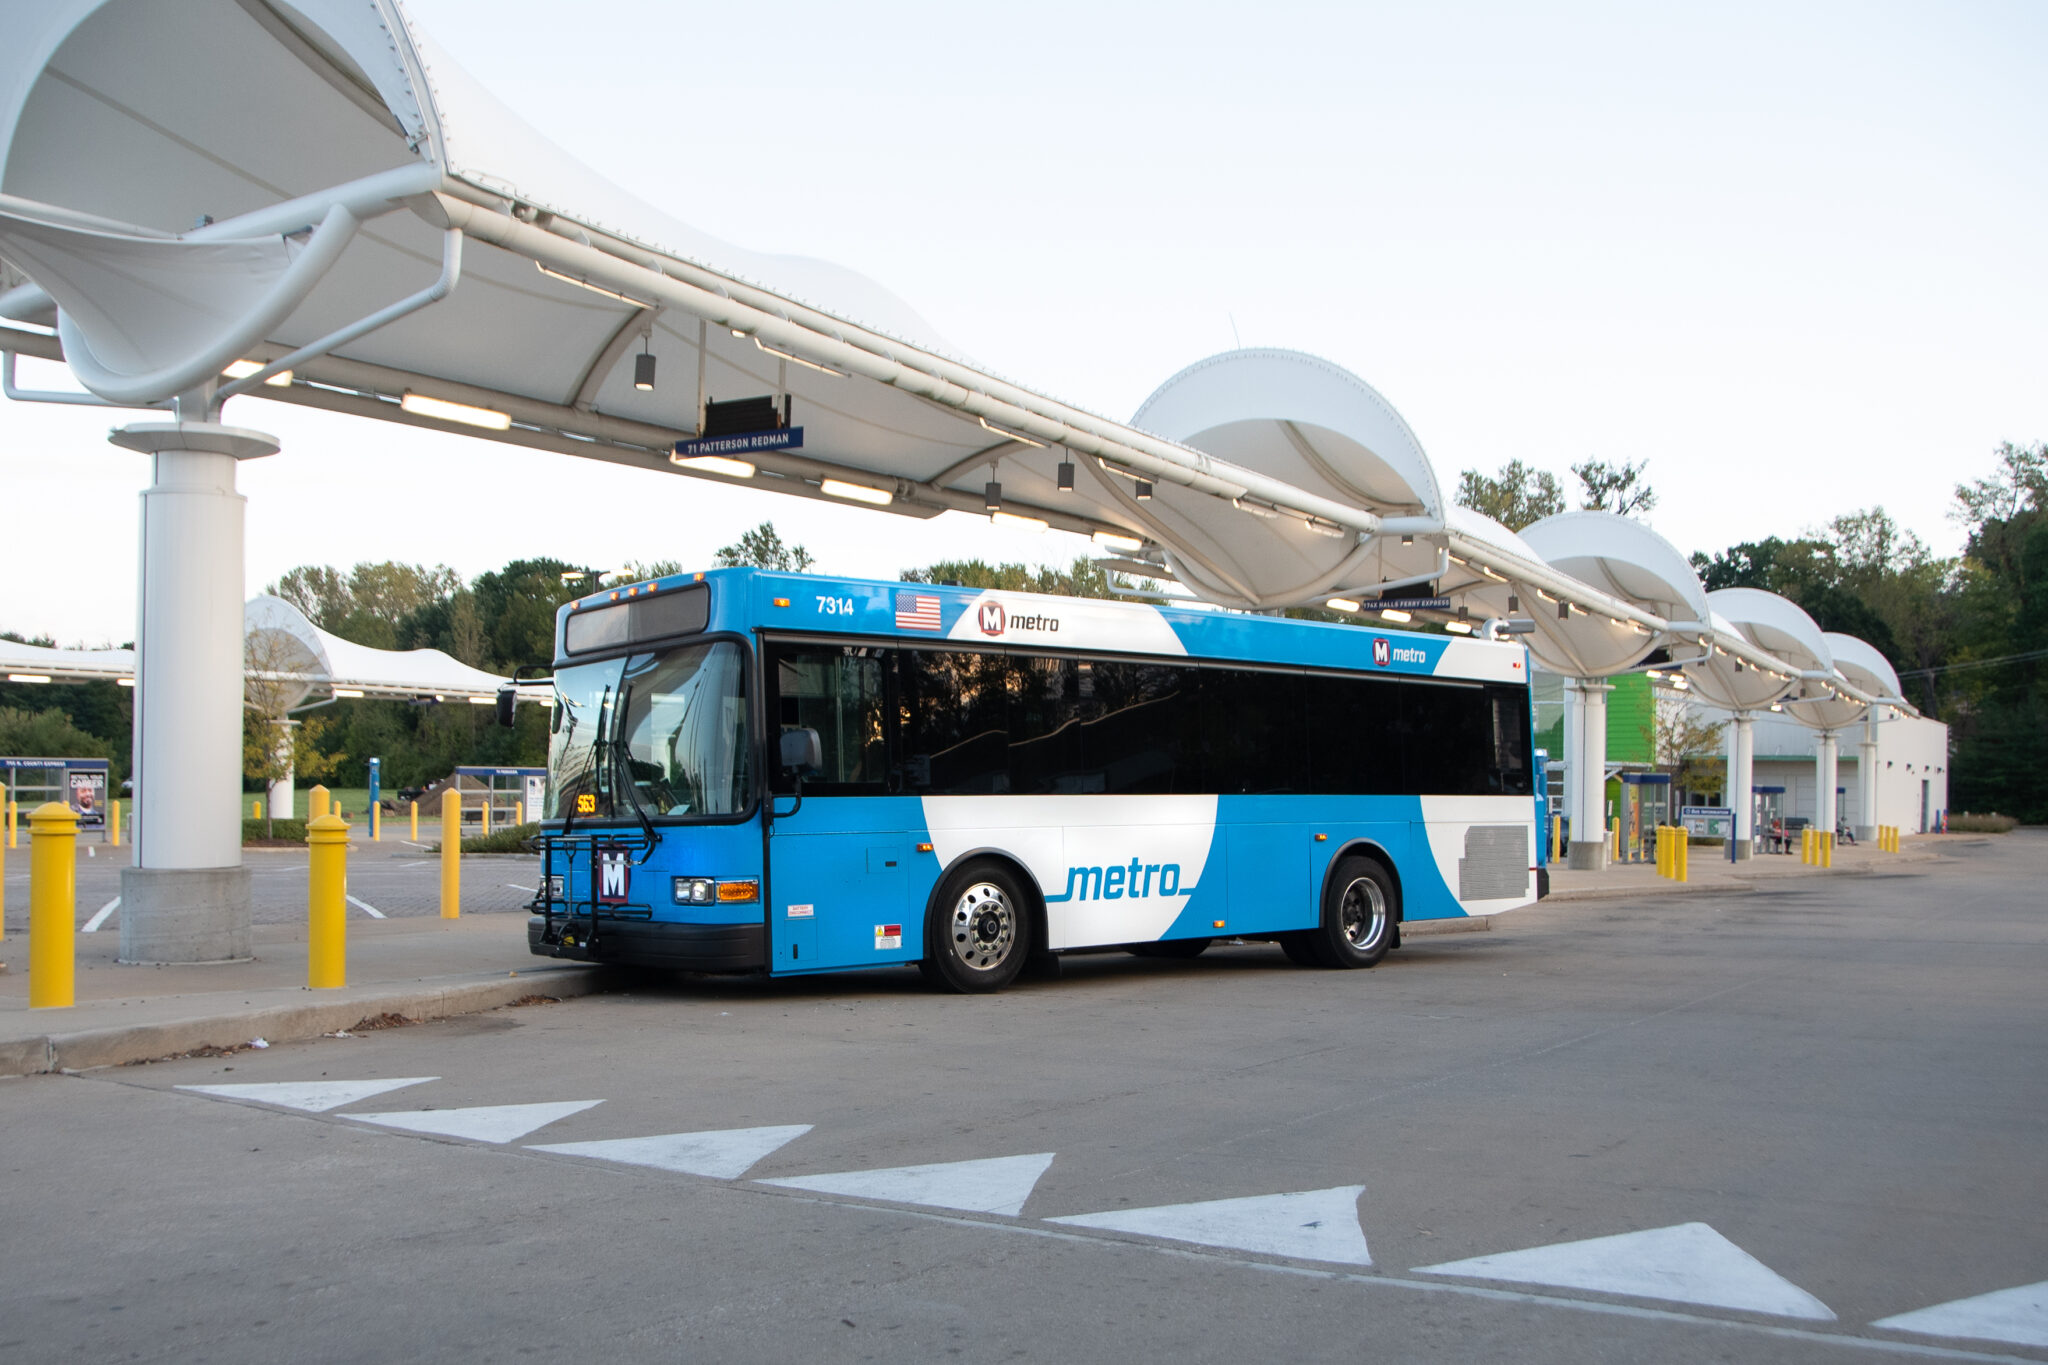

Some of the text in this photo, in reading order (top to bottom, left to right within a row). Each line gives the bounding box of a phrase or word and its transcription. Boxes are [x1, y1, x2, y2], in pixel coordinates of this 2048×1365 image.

[687, 433, 789, 454] 71 PATTERSON REDMAN
[815, 595, 854, 616] 7314
[1379, 600, 1399, 608] HALLS
[1400, 600, 1420, 608] FERRY
[1421, 599, 1450, 607] EXPRESS
[1010, 613, 1060, 632] metro
[1392, 647, 1426, 664] metro
[577, 794, 596, 813] 563
[1064, 857, 1181, 902] metro
